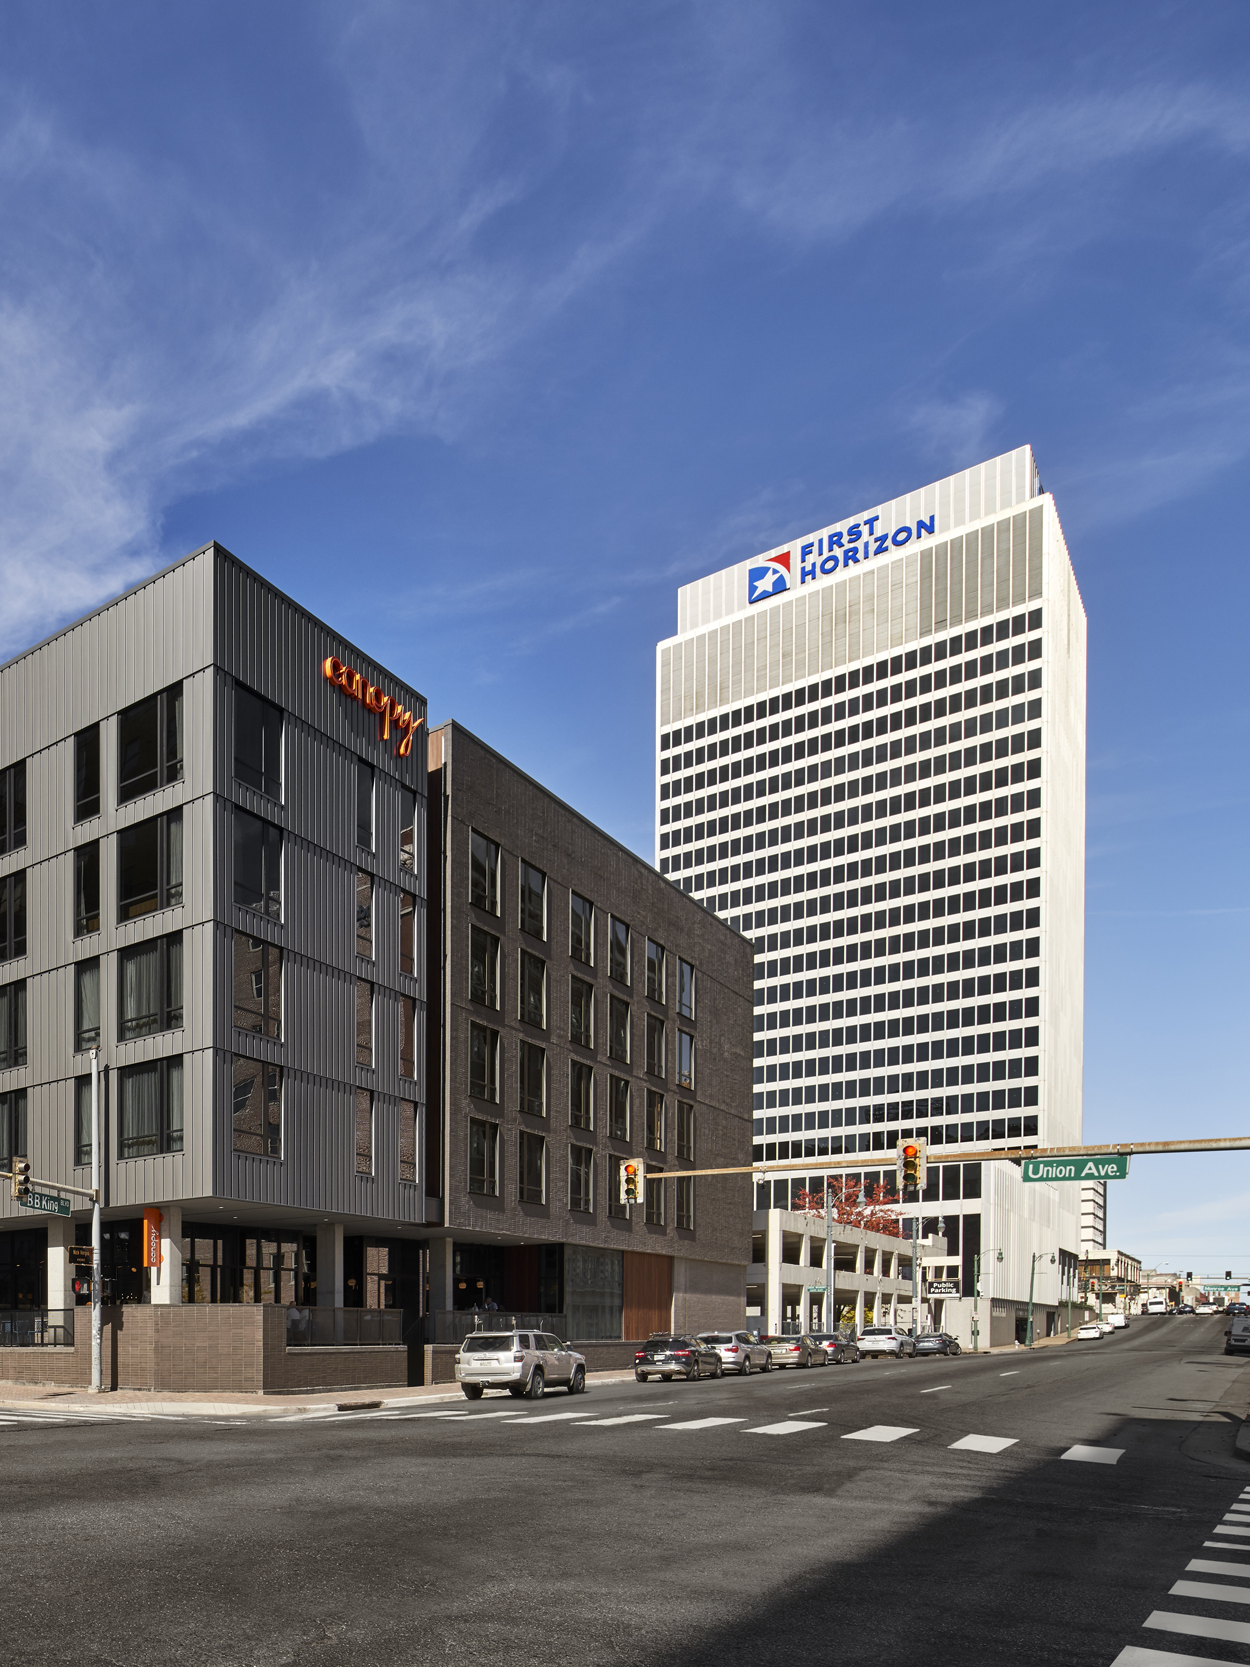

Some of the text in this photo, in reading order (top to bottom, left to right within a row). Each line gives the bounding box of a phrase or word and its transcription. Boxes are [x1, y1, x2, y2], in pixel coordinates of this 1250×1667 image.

[800, 514, 880, 563] FIRST
[800, 514, 936, 584] HORIZON
[323, 656, 425, 757] canopy
[1028, 1161, 1120, 1179] Union Ave.
[42, 1195, 58, 1213] King
[60, 1199, 70, 1207] BLVD
[150, 1224, 160, 1263] canopy
